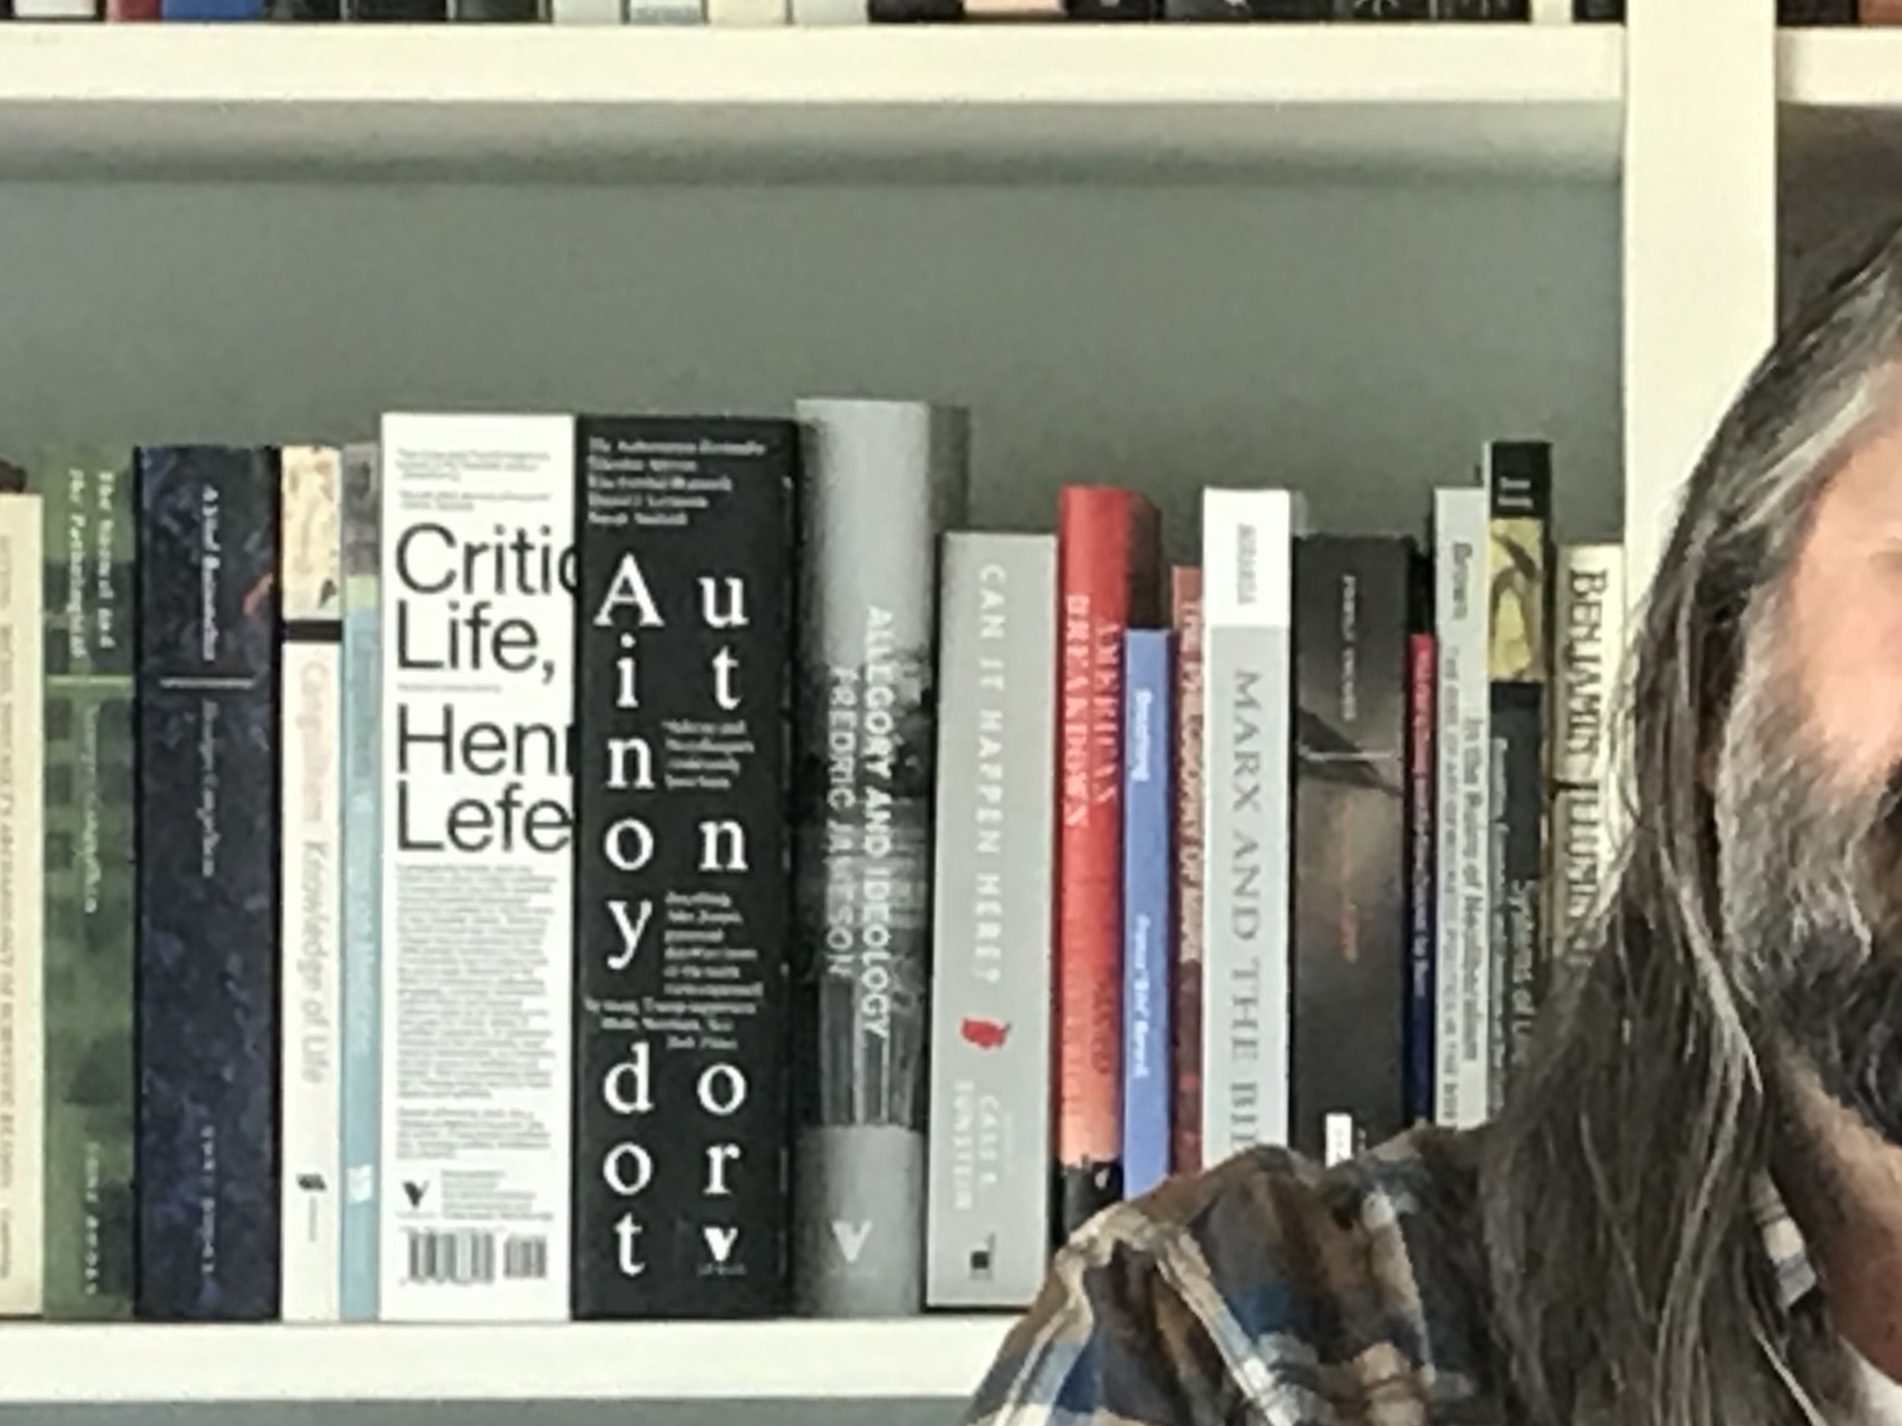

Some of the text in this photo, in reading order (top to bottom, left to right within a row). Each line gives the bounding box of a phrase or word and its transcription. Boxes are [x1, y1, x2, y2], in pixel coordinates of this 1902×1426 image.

[396, 600, 557, 685] Life,
[1064, 594, 1092, 828] BREAKDOWN
[1092, 618, 1120, 805] AMERICAN
[972, 563, 1007, 984] CAN IT HAPPEN HERE?
[1234, 668, 1262, 813] MARX
[824, 666, 858, 978] FREDRIC JAMESON
[861, 605, 895, 1039] ALLEGORY AND IDEOLOGY
[1232, 829, 1262, 941] AND
[297, 840, 330, 993] Knowledge
[302, 998, 330, 1027] of
[302, 1035, 330, 1083] Life
[1230, 958, 1261, 1062] THE
